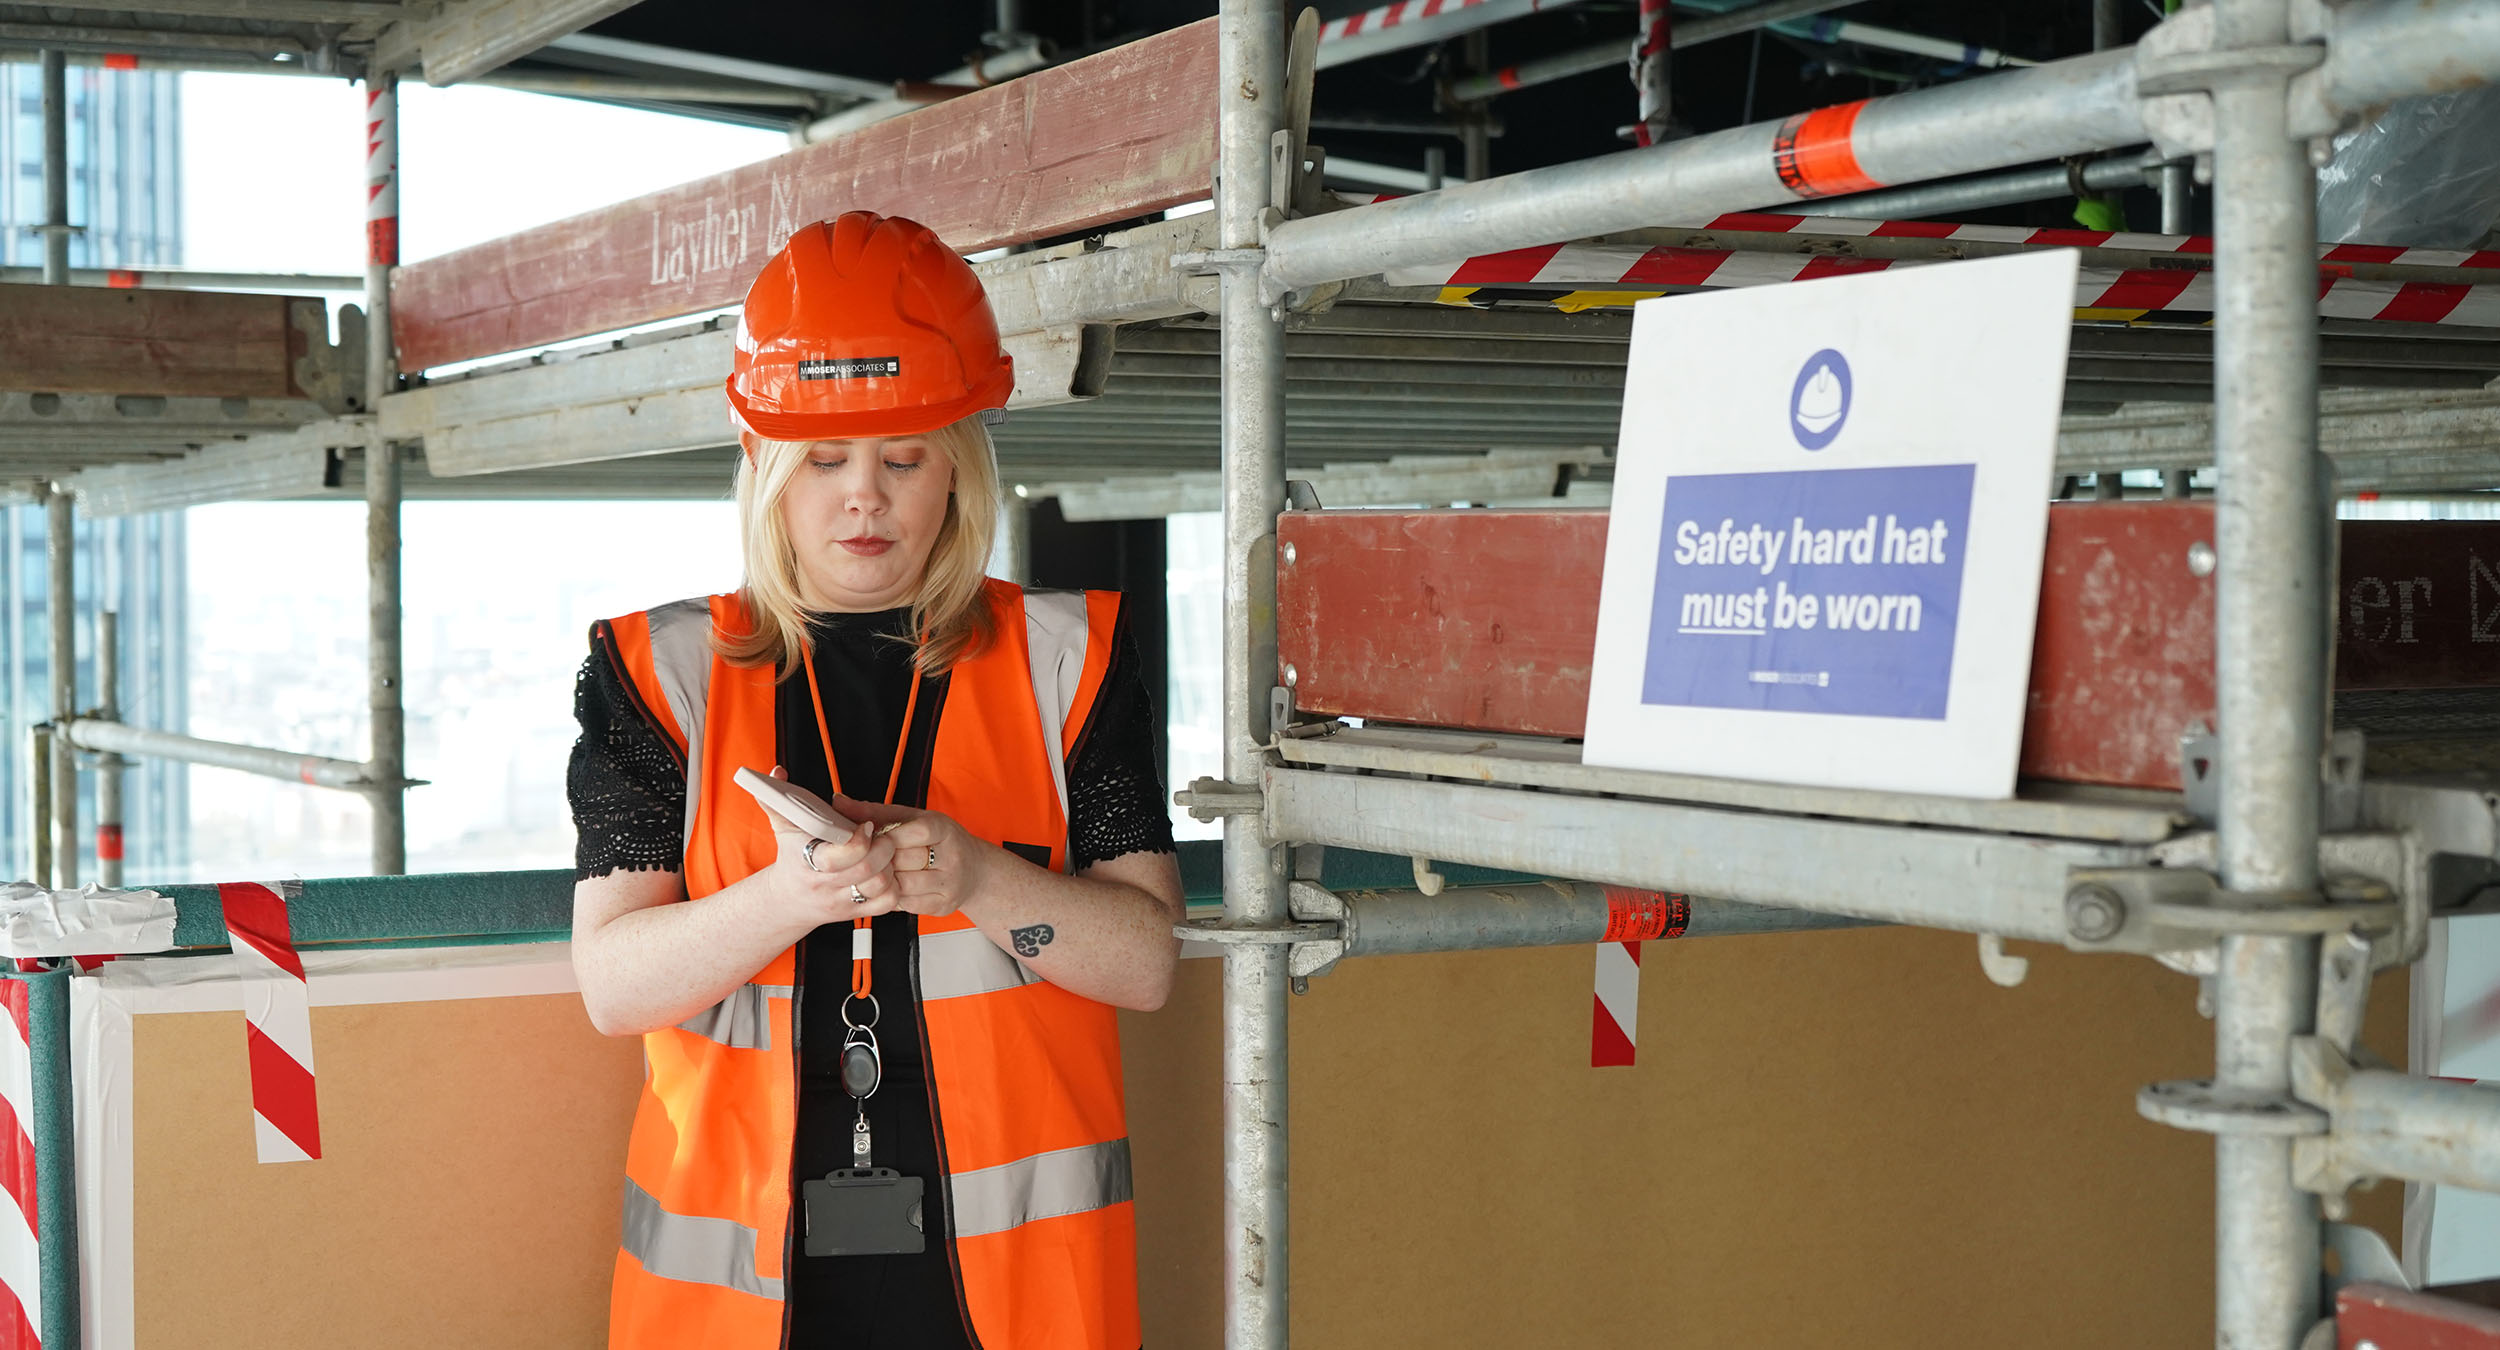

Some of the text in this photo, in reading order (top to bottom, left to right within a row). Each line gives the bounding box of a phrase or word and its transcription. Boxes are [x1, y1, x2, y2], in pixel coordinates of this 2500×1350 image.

[650, 196, 756, 294] Layher
[1674, 514, 1949, 575] Safety hard hat
[1679, 581, 1922, 631] must be worn
[2337, 576, 2433, 644] er
